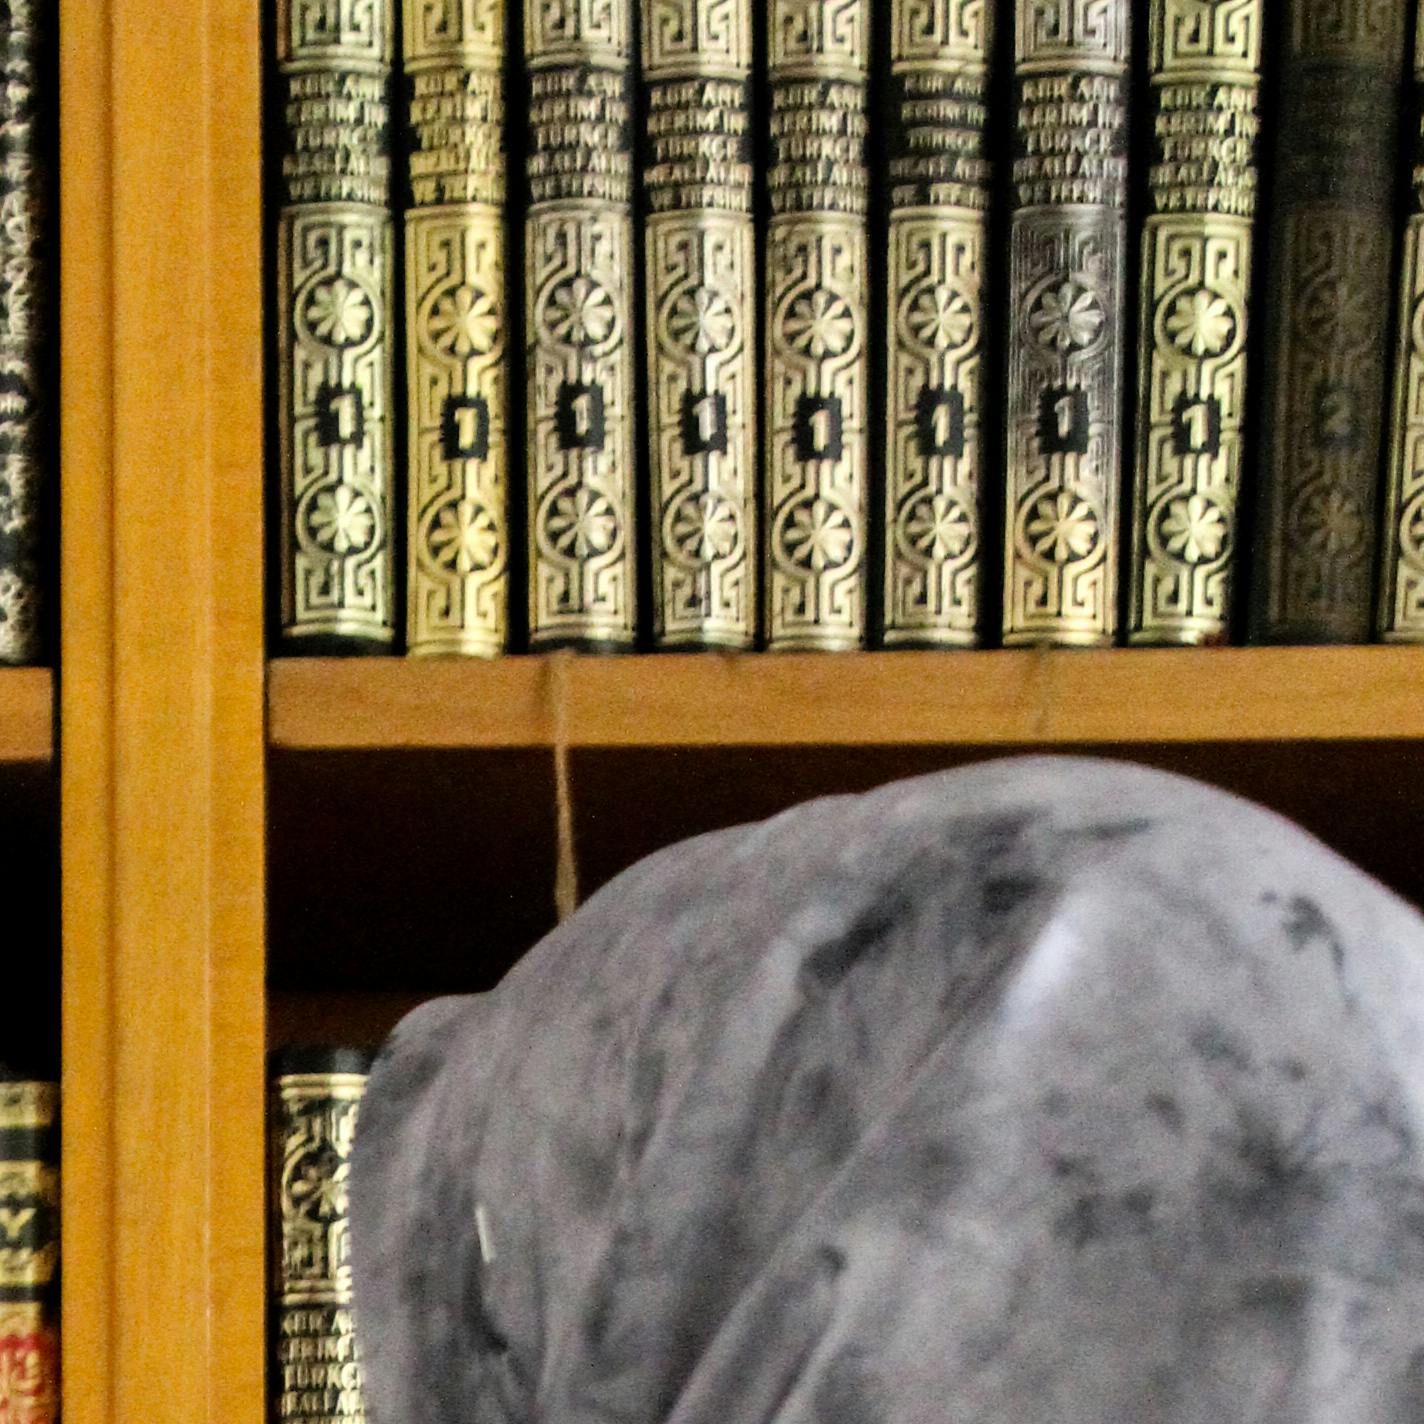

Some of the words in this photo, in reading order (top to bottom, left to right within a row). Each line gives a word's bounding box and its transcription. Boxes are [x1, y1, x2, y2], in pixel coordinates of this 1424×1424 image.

[329, 396, 351, 439] 1
[454, 405, 475, 449] 1
[571, 394, 590, 437] 1
[692, 399, 717, 442] 1
[808, 408, 831, 452] 1
[930, 405, 951, 448] 1
[1055, 397, 1073, 439] 1
[1182, 405, 1209, 449] 1
